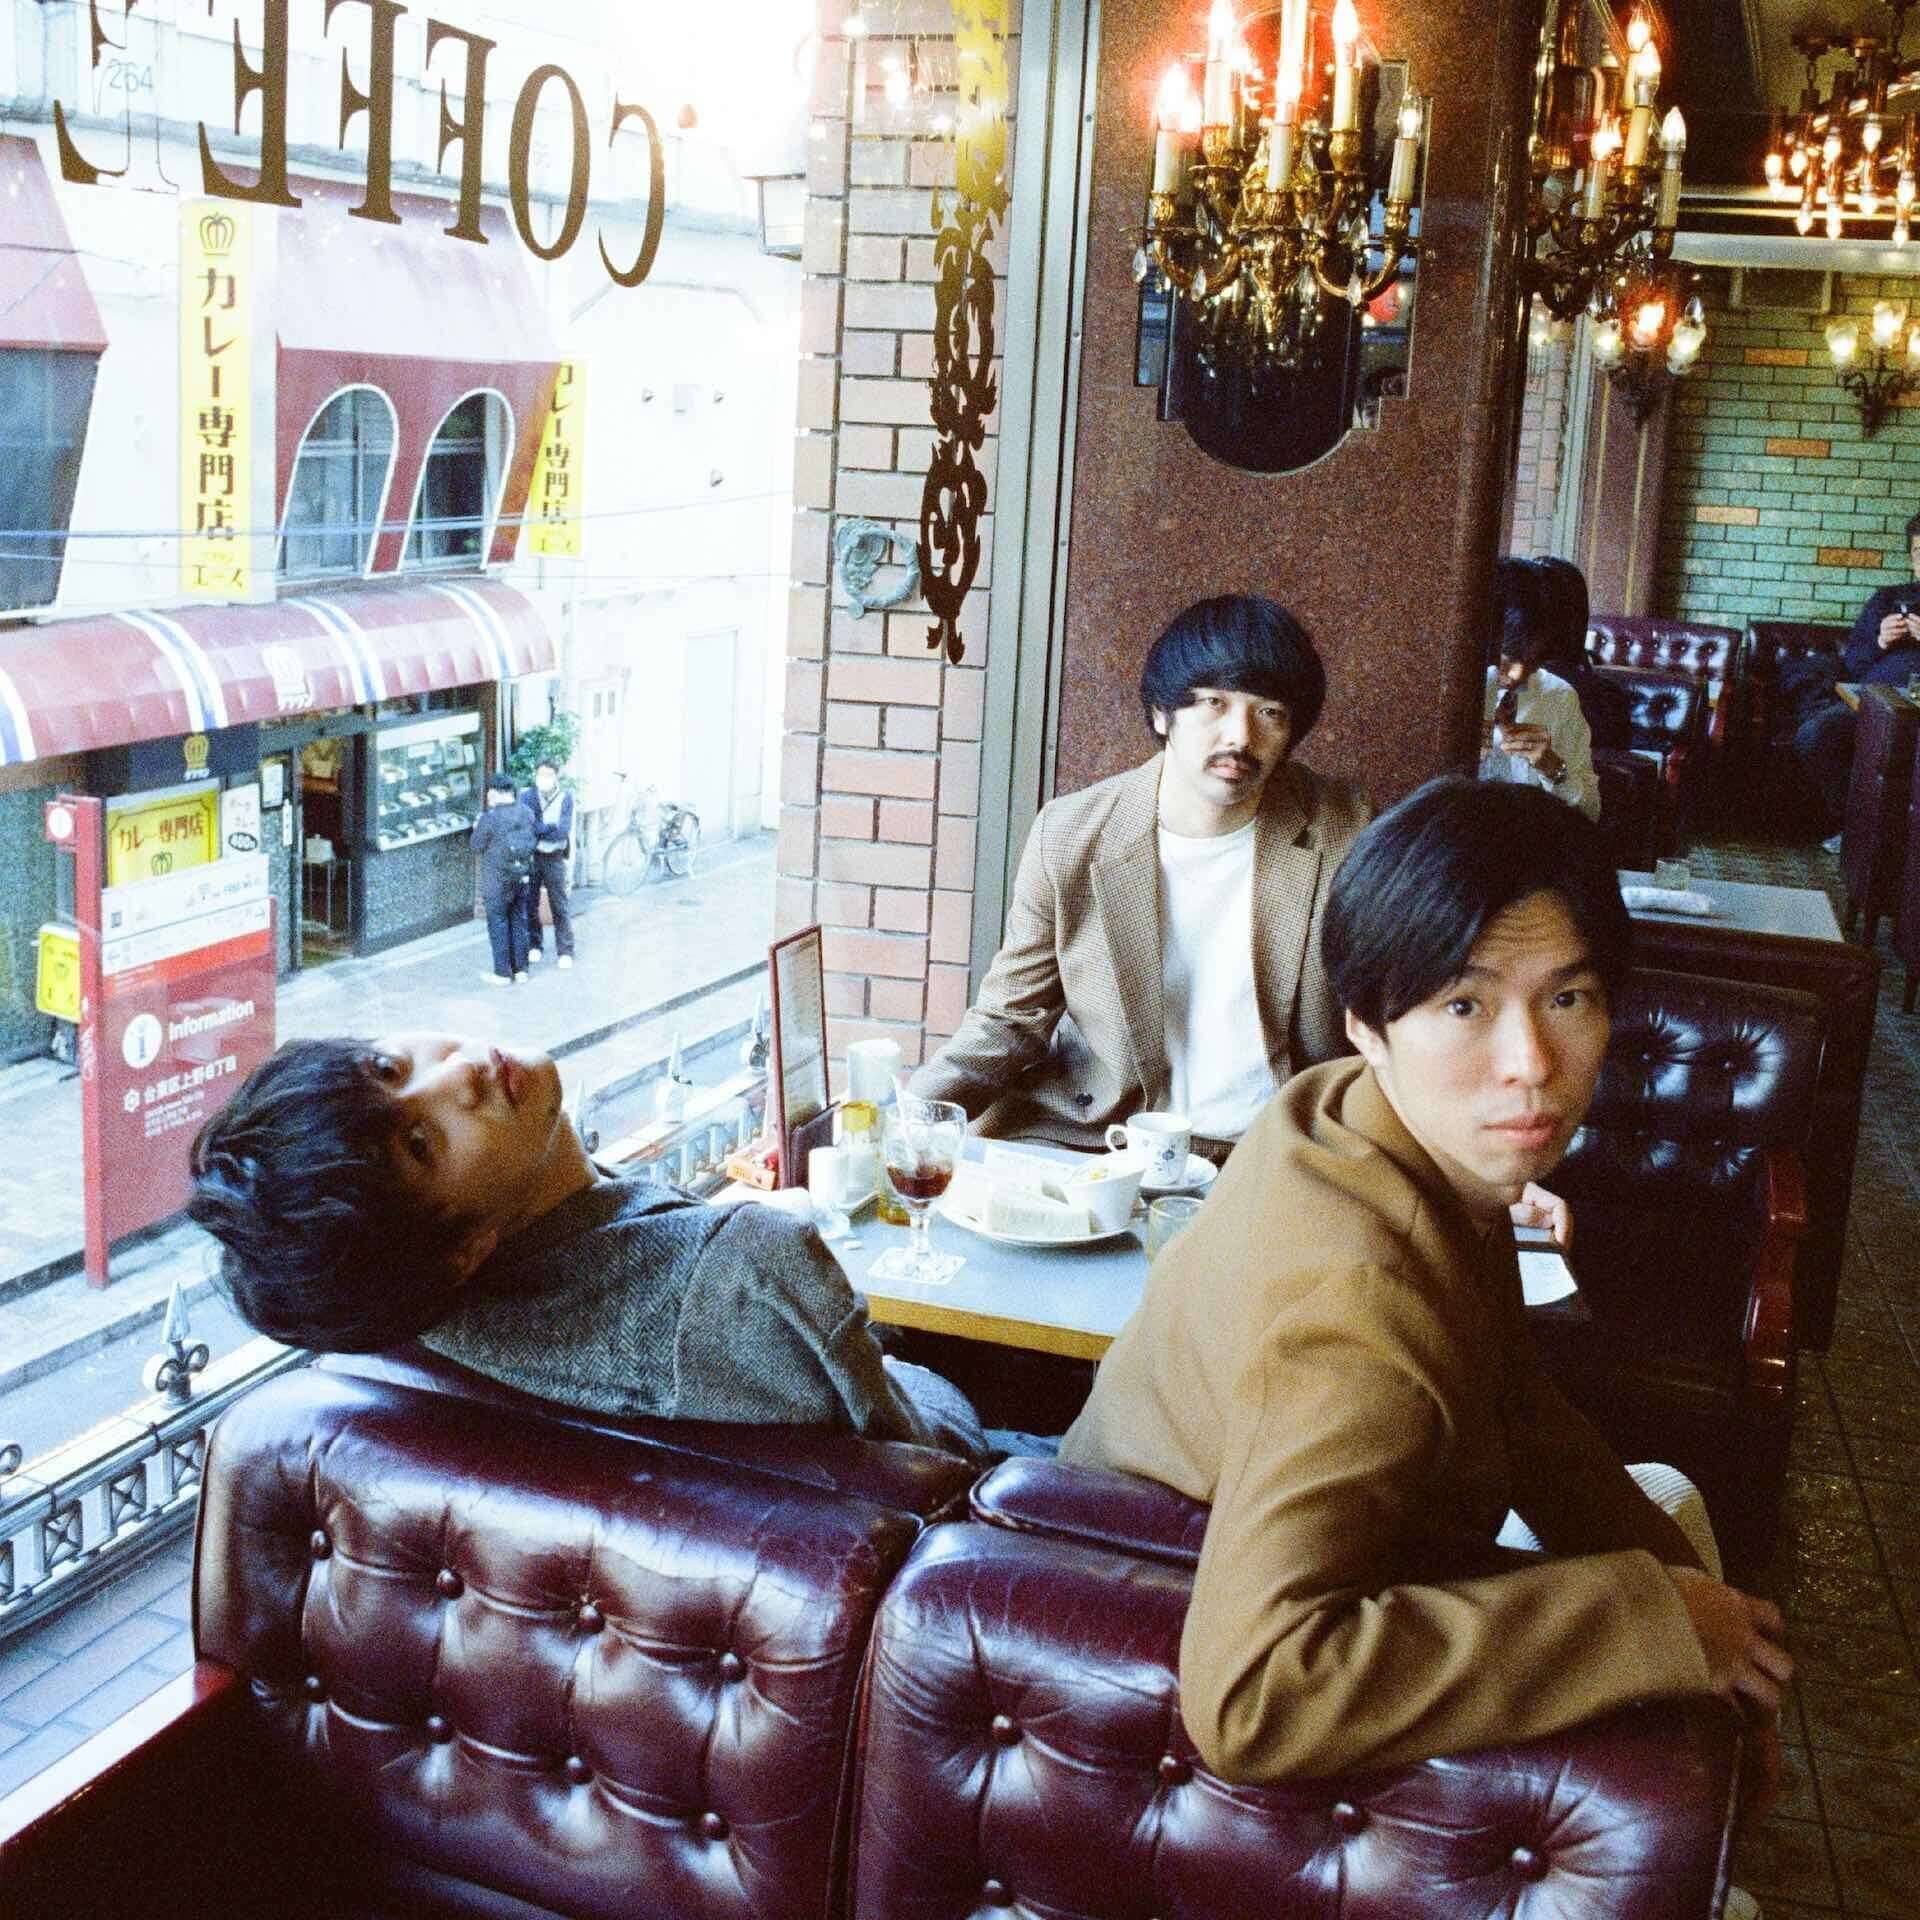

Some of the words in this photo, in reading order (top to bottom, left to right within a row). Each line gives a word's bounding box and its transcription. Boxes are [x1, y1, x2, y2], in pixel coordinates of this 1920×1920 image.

[196, 267, 238, 541] カレー専門店
[119, 812, 205, 851] カレー専門店
